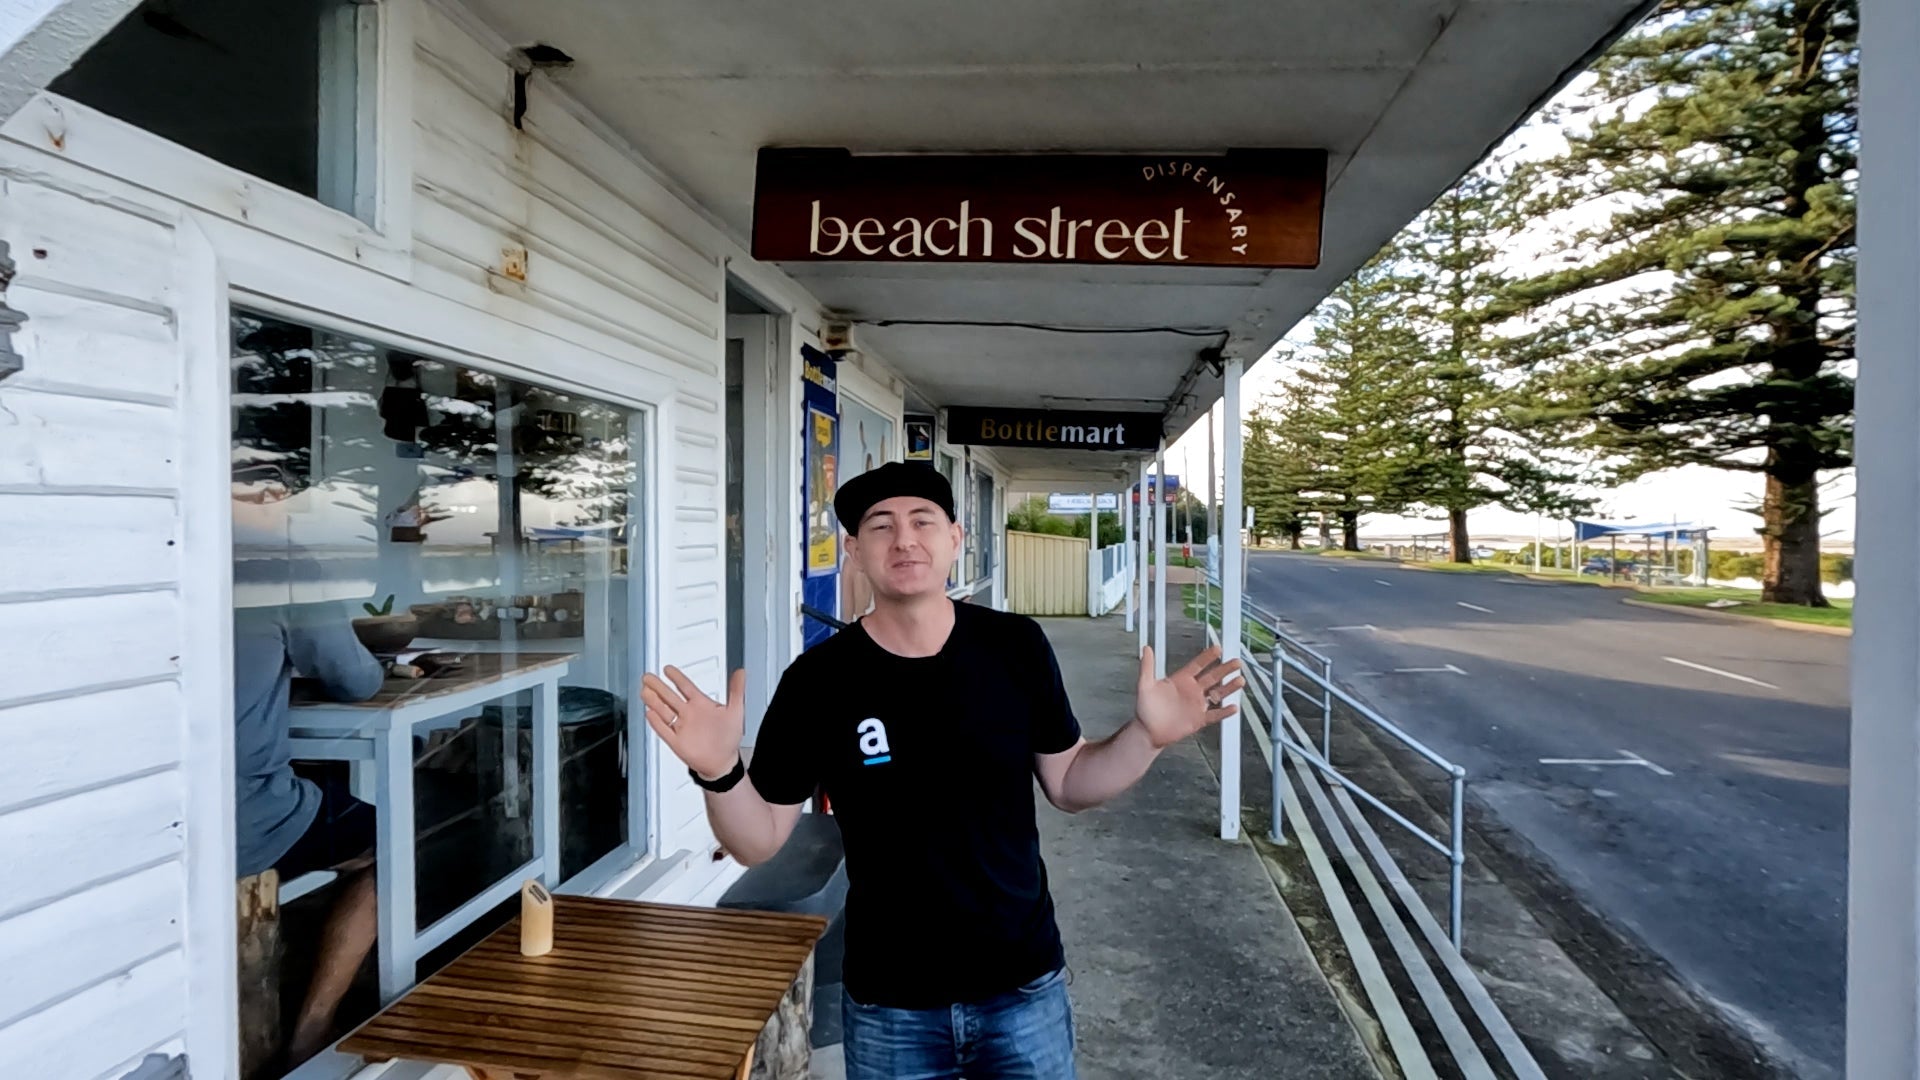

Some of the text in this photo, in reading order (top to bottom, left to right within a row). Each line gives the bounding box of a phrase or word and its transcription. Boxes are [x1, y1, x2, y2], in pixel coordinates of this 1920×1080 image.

[810, 199, 1191, 260] beach street
[1142, 161, 1248, 255] DISPENSARY
[980, 418, 1126, 445] Bottlemart
[857, 717, 890, 756] a
